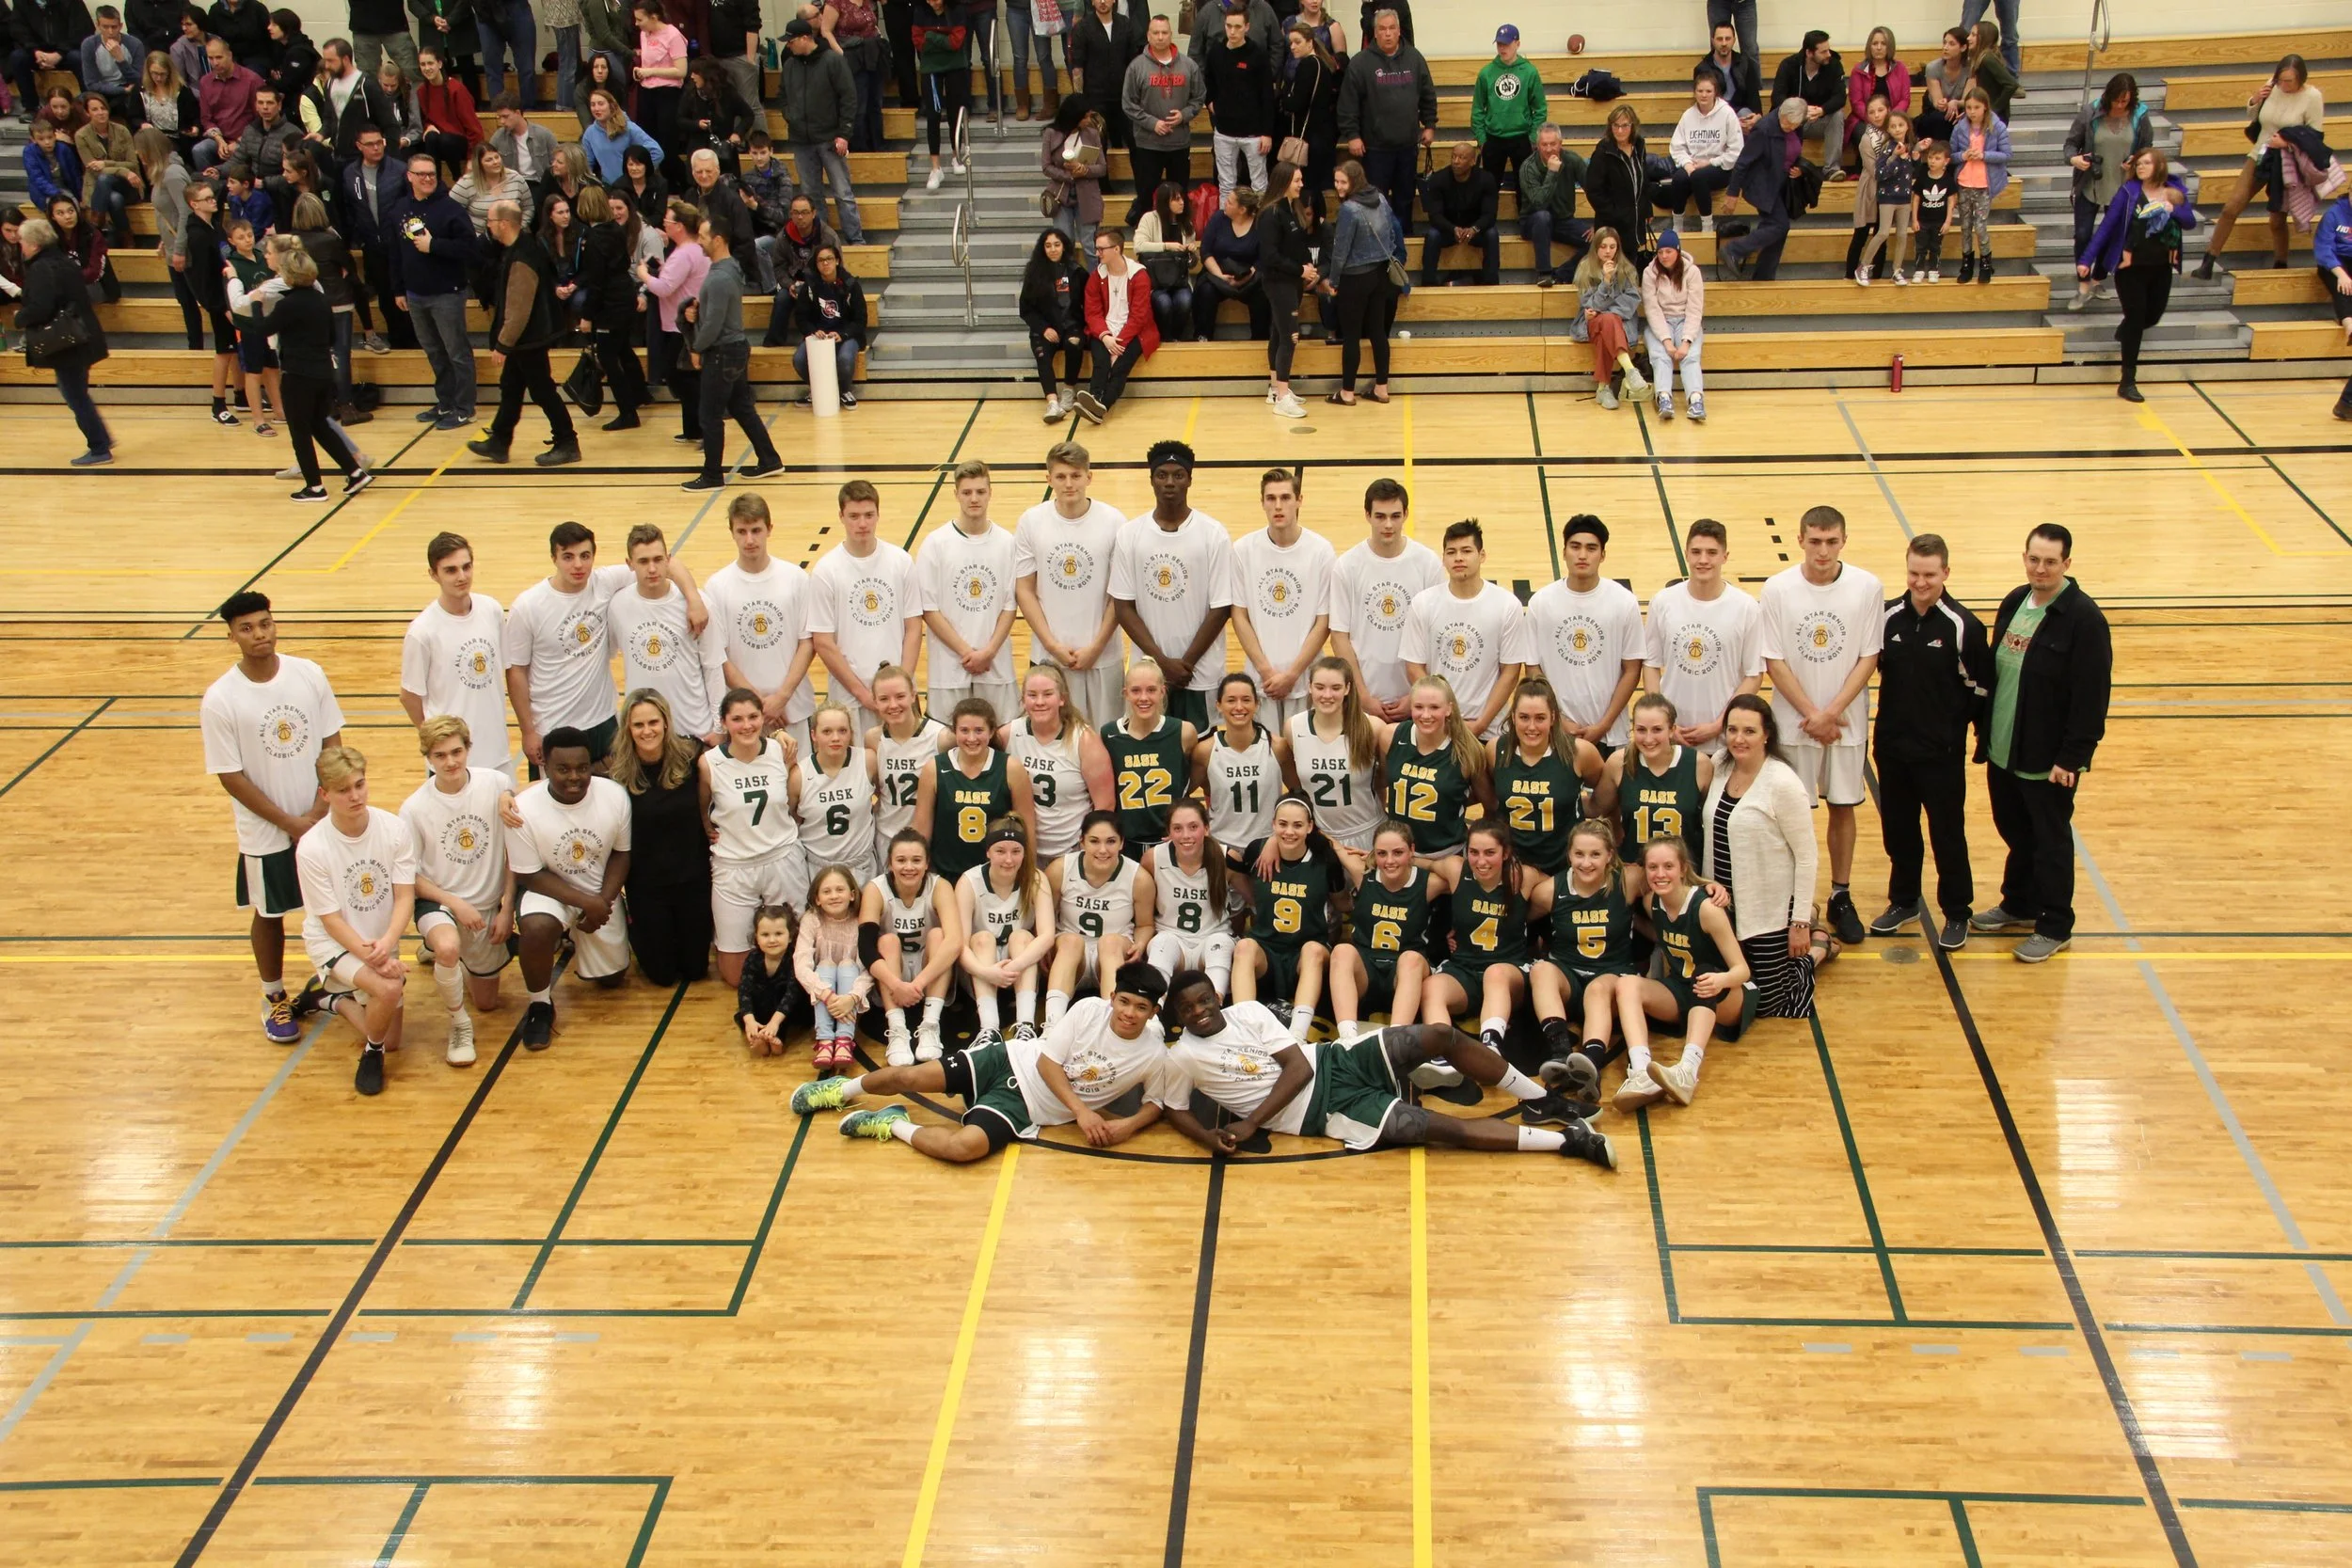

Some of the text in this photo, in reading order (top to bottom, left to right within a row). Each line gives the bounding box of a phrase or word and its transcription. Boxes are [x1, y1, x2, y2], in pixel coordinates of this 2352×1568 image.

[1046, 543, 1094, 566] ALL STAR SENIOR
[1150, 553, 1169, 562] STAR
[1171, 556, 1188, 579] SENIOR
[952, 564, 997, 589] ALL STAR SENIOR
[1049, 573, 1092, 591] CLASSIC 2019
[1285, 570, 1302, 594] SENIOR
[853, 578, 871, 589] STAR
[874, 578, 894, 597] SENIOR
[1171, 588, 1185, 601] 2019
[1372, 581, 1391, 592] STAR
[742, 600, 761, 611] STAR
[764, 601, 784, 622] SENIOR
[956, 595, 993, 612] CLASSIC 2019
[1285, 603, 1299, 617] 2019
[564, 611, 581, 626] STAR
[852, 606, 894, 626] CLASSIC 2019
[1367, 614, 1394, 631] CLASSIC
[1796, 610, 1846, 636] ALL STAR SENIOR
[629, 630, 638, 644] ALL
[637, 621, 657, 630] STAR
[660, 624, 679, 646] SENIOR
[1436, 622, 1484, 649] ALL STAR SENIOR
[1555, 626, 1564, 640] ALL
[1563, 615, 1582, 625] STAR
[1585, 616, 1605, 641] SENIOR
[460, 638, 476, 652] STAR
[740, 630, 783, 649] CLASSIC 2019
[1681, 624, 1701, 632] STAR
[1704, 626, 1722, 652] SENIOR
[631, 653, 677, 672] CLASSIC 2019
[1557, 648, 1602, 666] CLASSIC 2019
[1828, 646, 1843, 660] 2019
[1465, 657, 1481, 672] 2019
[1675, 655, 1718, 675] CLASSIC 2019
[264, 705, 281, 721] STAR
[284, 705, 309, 725] SENIOR
[265, 735, 309, 758] CLASSIC 2019
[887, 759, 916, 770] SASK
[1024, 756, 1055, 771] SASK
[1124, 753, 1159, 768] SASK
[1311, 759, 1346, 769] SASK
[1227, 766, 1259, 777] SASK
[1401, 762, 1438, 782] SASK
[735, 775, 770, 789] SASK
[884, 773, 919, 807] 12
[1033, 773, 1056, 808] 3
[1118, 768, 1172, 810] 22
[1311, 773, 1352, 807] 21
[1512, 780, 1549, 794] SASK
[819, 788, 853, 802] SASK
[955, 790, 991, 804] SASK
[1231, 780, 1258, 813] 11
[1393, 778, 1438, 822] 12
[1640, 789, 1677, 804] SASK
[743, 789, 769, 827] 7
[1505, 796, 1553, 832] 21
[447, 815, 466, 828] STAR
[469, 815, 489, 832] SENIOR
[826, 804, 850, 835] 6
[958, 806, 987, 843] 8
[1634, 805, 1682, 843] 13
[561, 828, 580, 841] STAR
[582, 829, 603, 848] SENIOR
[445, 842, 489, 865] CLASSIC 2019
[347, 859, 365, 873] STAR
[557, 863, 587, 875] CLASSIC
[375, 888, 389, 904] 2019
[1173, 887, 1207, 900] SASK
[1271, 881, 1307, 897] SASK
[1075, 896, 1109, 911] SASK
[1372, 903, 1407, 921] SASK
[895, 918, 925, 929] SASK
[988, 910, 1019, 924] SASK
[1177, 902, 1202, 933] 8
[1273, 897, 1301, 933] 9
[1572, 910, 1609, 924] SASK
[1079, 912, 1104, 938] 9
[1470, 917, 1499, 951] 4
[898, 932, 926, 953] 5
[1372, 920, 1402, 951] 6
[1577, 926, 1606, 958] 5
[1667, 946, 1695, 978] 7
[1073, 1053, 1084, 1062] ALL
[1088, 1051, 1107, 1063] STAR
